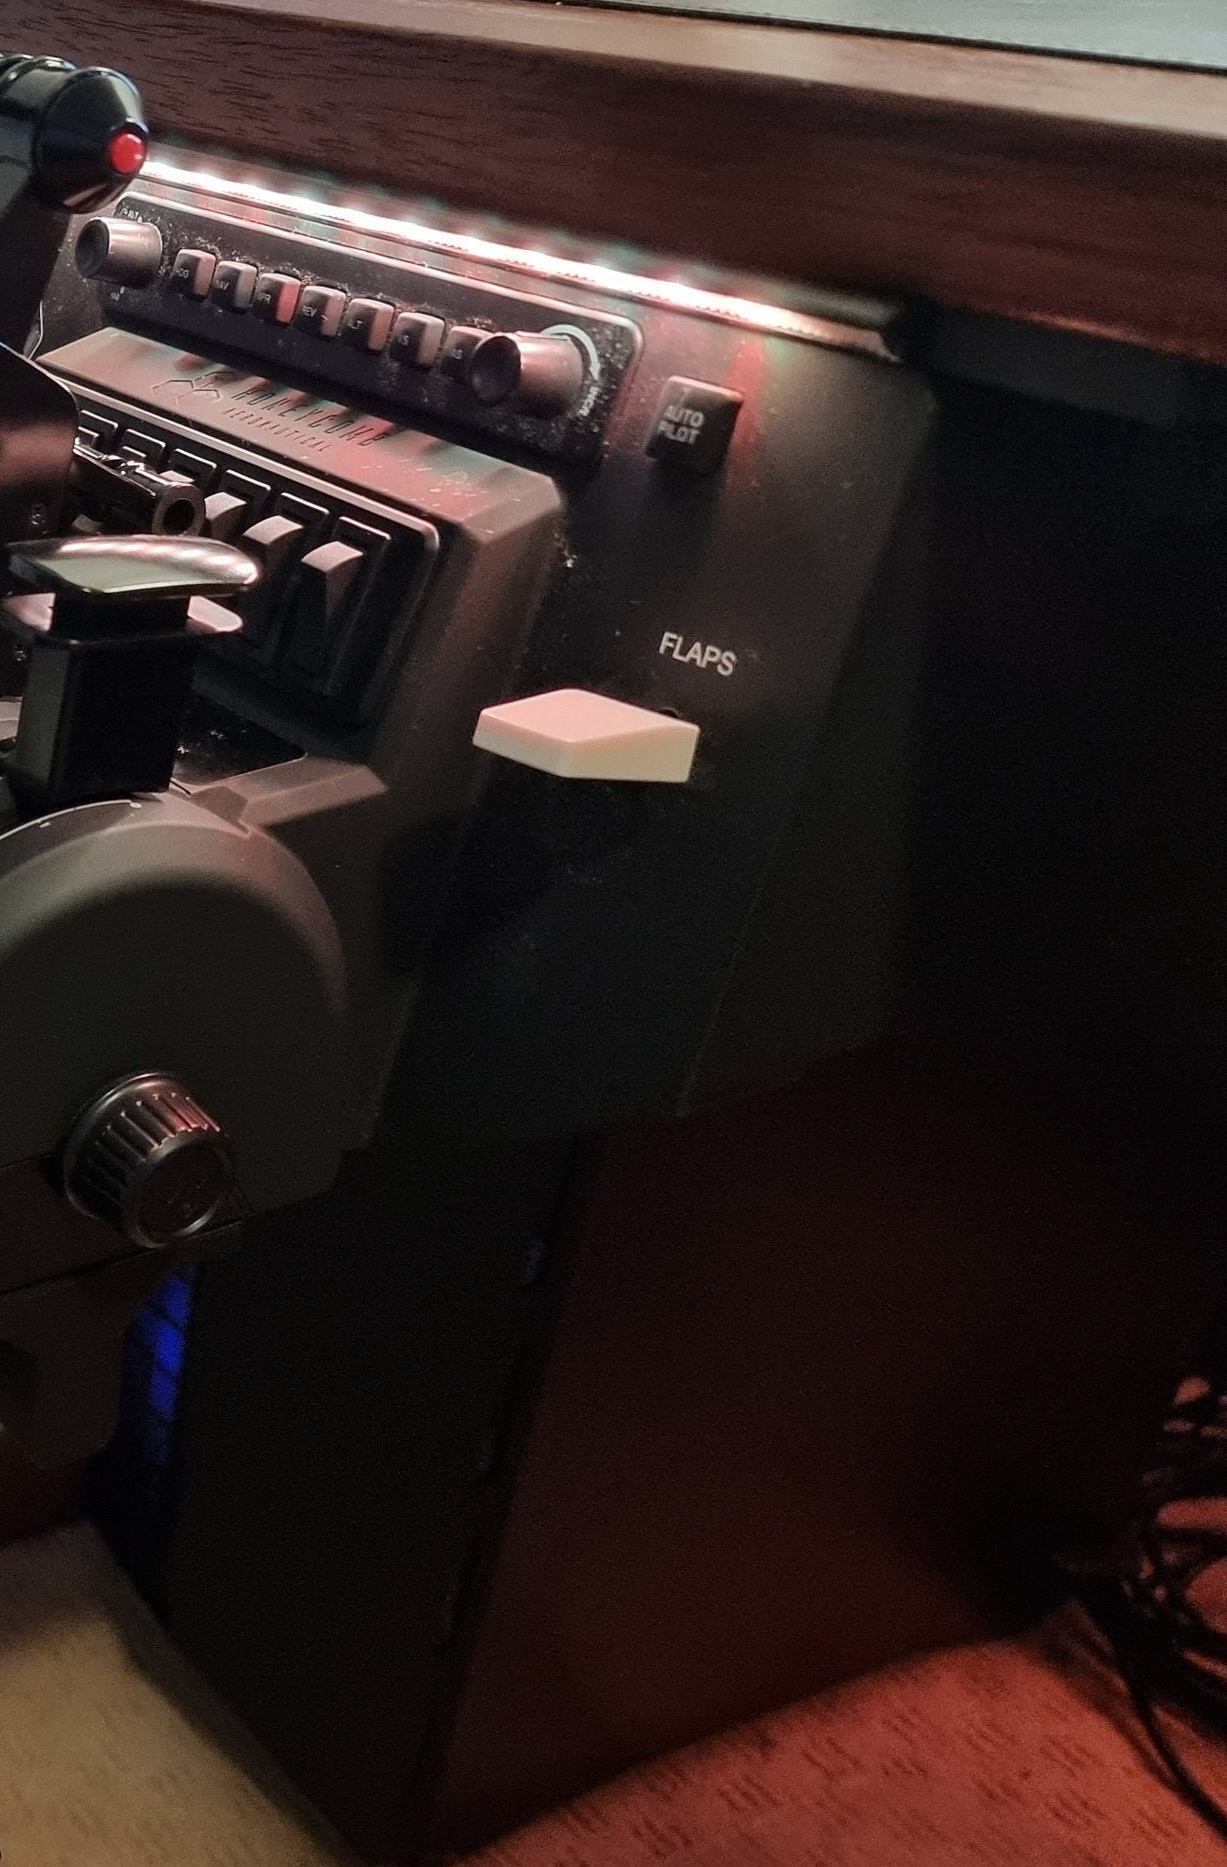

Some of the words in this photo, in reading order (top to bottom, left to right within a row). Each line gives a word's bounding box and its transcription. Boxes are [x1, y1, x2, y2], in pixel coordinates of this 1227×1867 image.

[230, 386, 390, 447] HONEYCOMB
[657, 420, 701, 444] PILOT
[663, 405, 705, 428] AUTO
[658, 631, 737, 677] FLAPS
